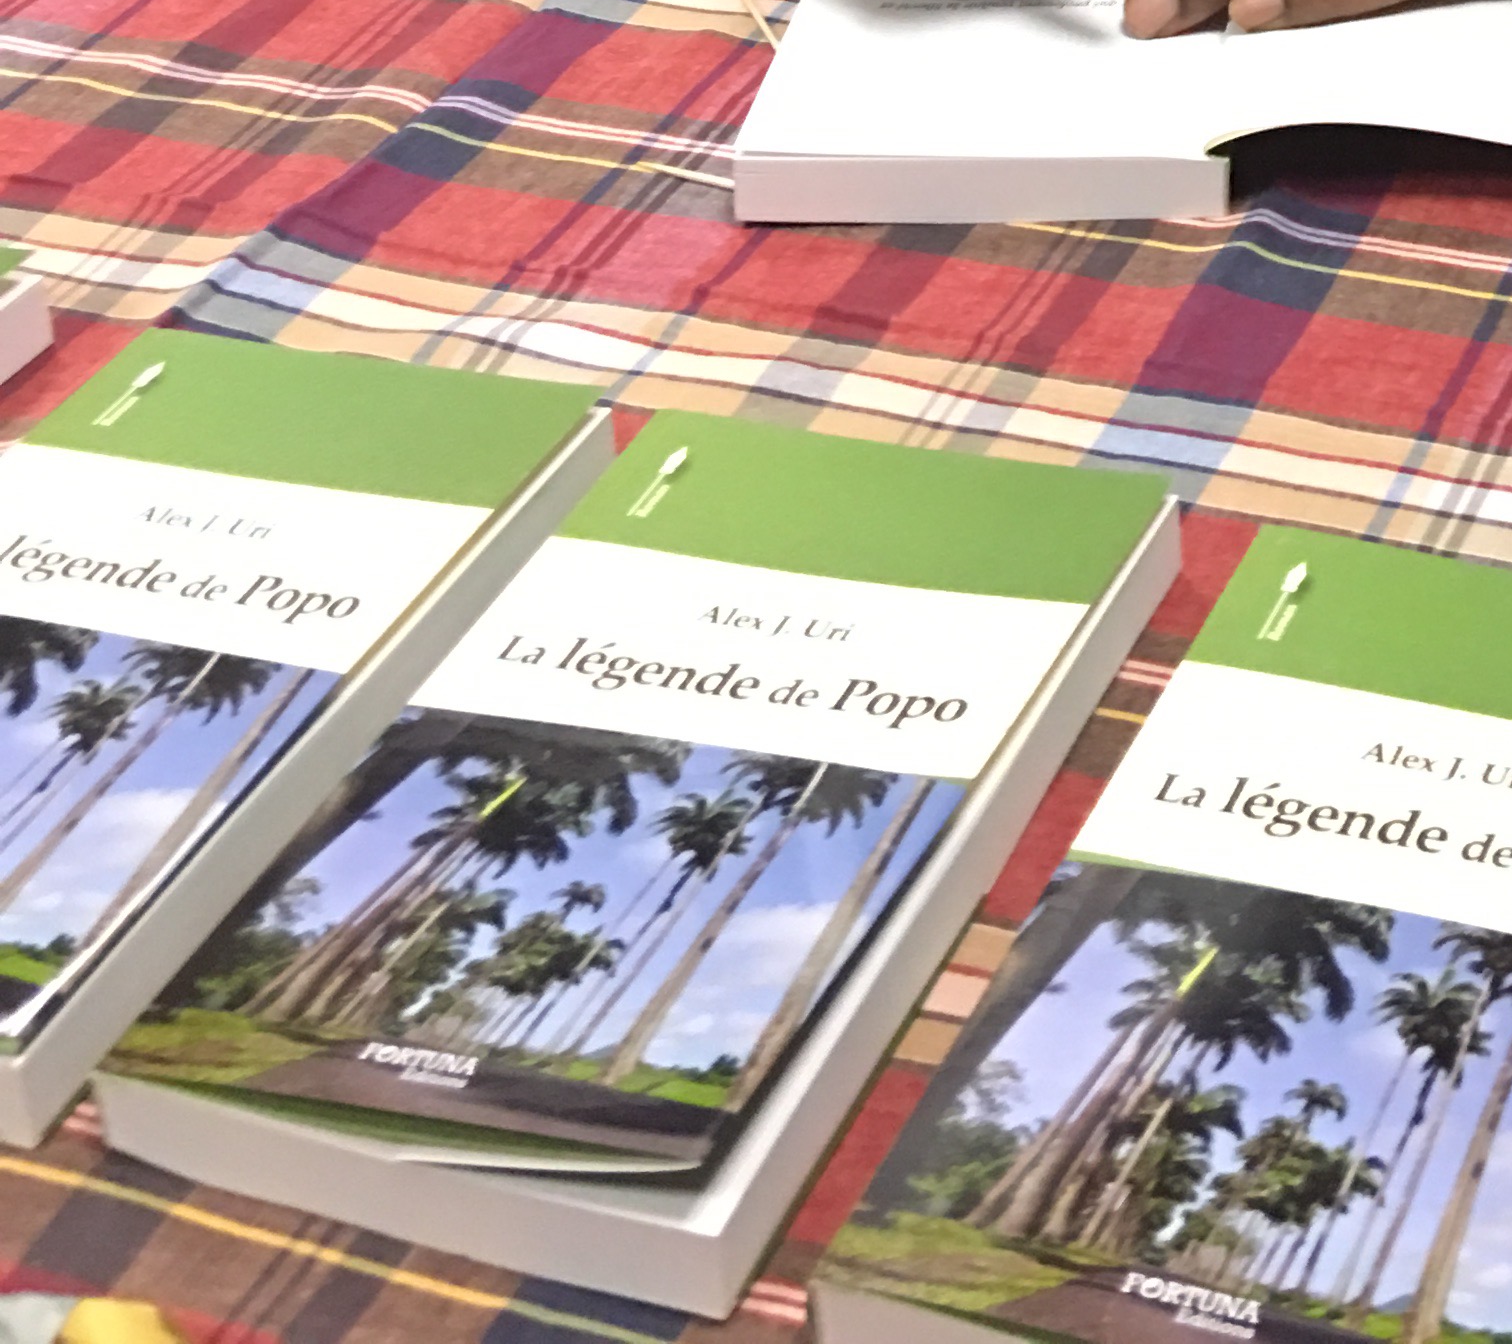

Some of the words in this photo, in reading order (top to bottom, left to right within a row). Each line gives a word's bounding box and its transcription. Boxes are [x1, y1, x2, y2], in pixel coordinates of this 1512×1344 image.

[137, 506, 193, 528] Alex
[228, 518, 276, 539] Uri
[0, 535, 177, 592] légende
[180, 575, 227, 601] de
[235, 575, 360, 624] Popo
[700, 605, 764, 631] Alex
[771, 615, 791, 637] J.
[803, 619, 856, 642] Uri
[497, 635, 545, 664] La
[556, 637, 762, 700] légende
[768, 680, 819, 707] de
[830, 679, 967, 729] Popo
[1362, 743, 1434, 772] Alex
[1445, 758, 1465, 780] J.
[1155, 773, 1206, 807] La
[1220, 777, 1448, 853] légende
[359, 1041, 479, 1075] FORTUNA
[1120, 1271, 1261, 1323] FORTUNA
